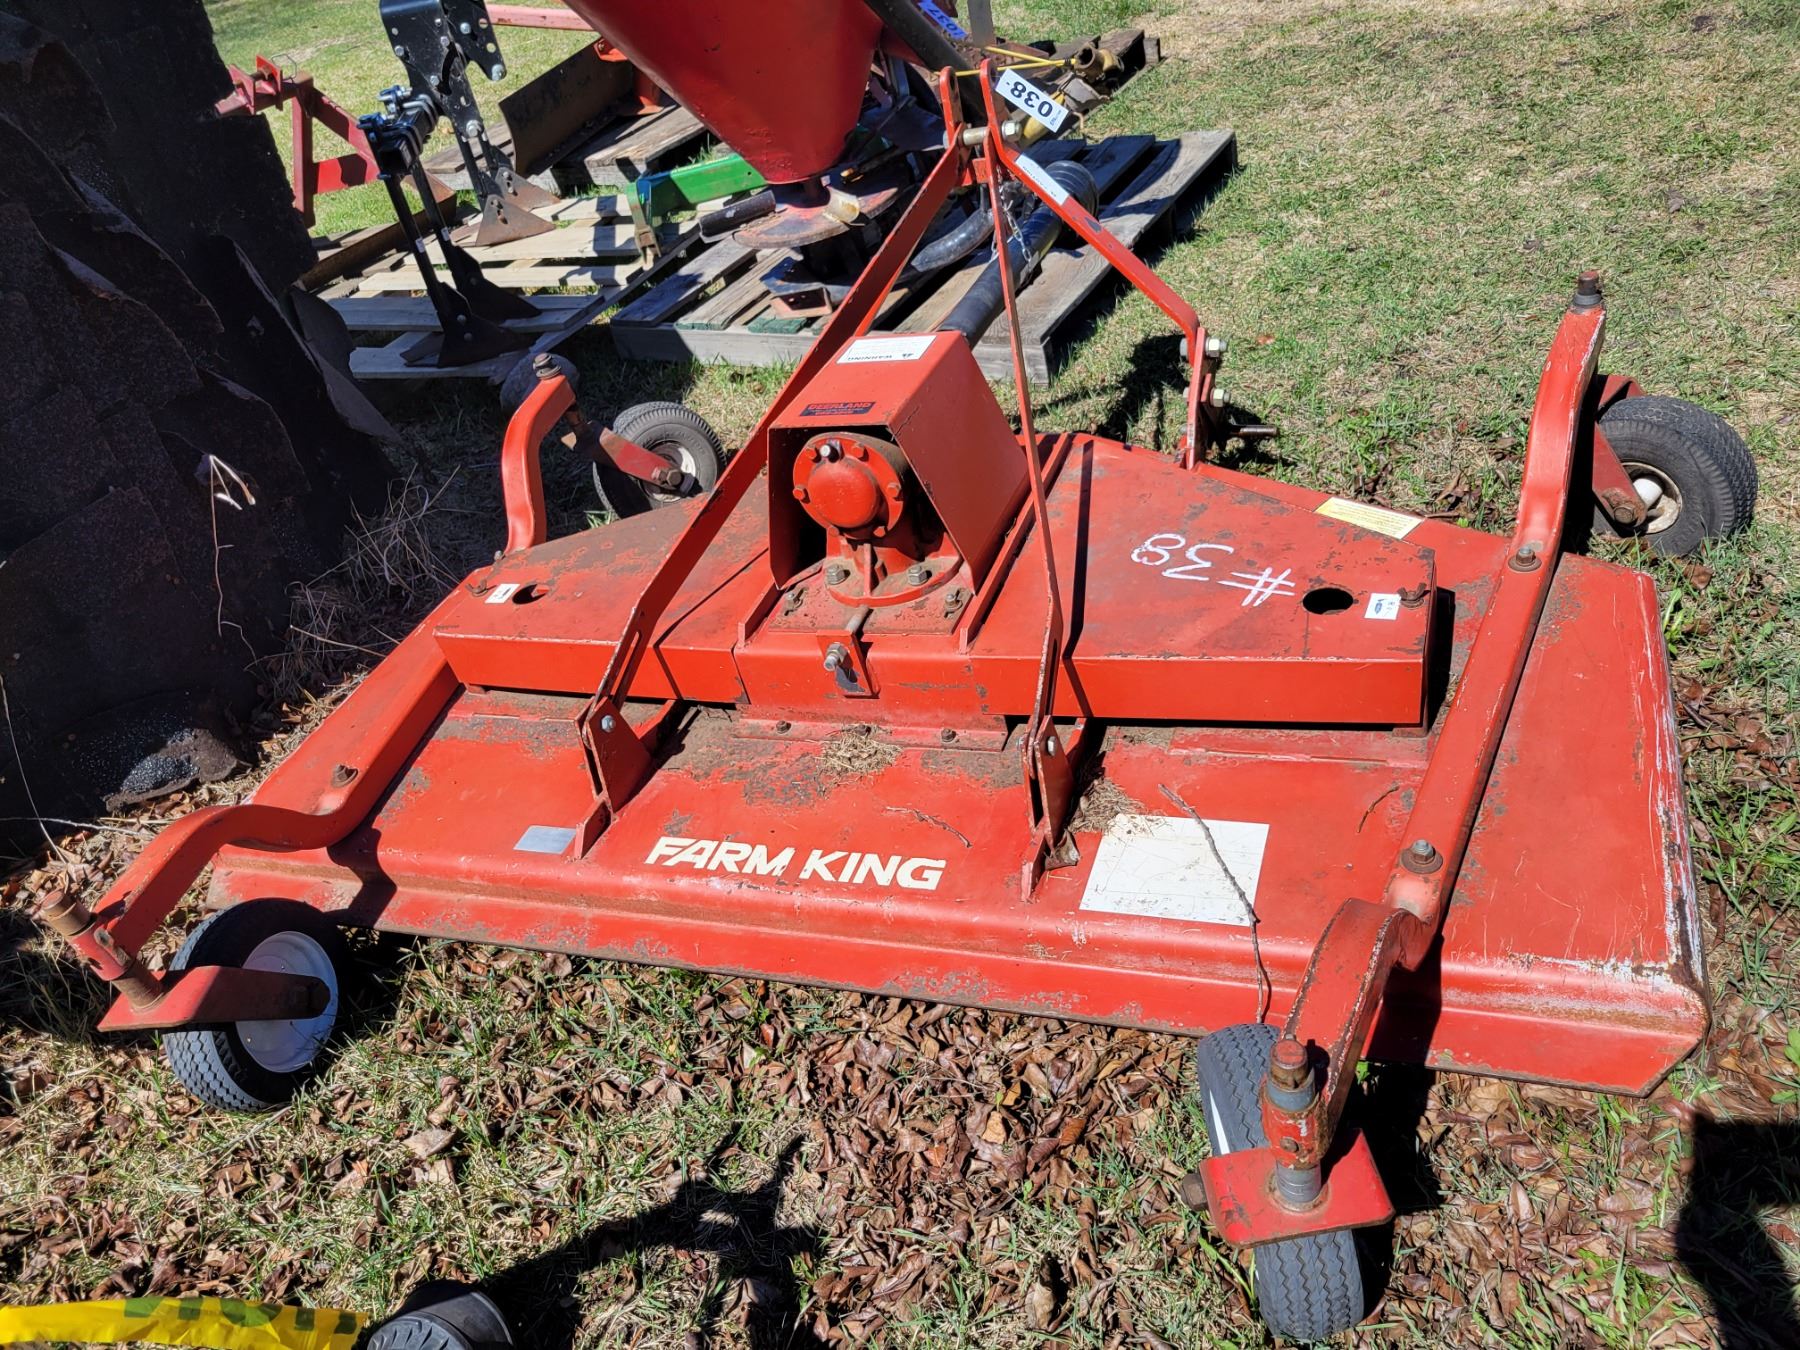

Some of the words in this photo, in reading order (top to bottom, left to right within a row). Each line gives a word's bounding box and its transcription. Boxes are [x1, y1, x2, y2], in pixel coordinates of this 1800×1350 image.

[1010, 81, 1053, 118] 038
[645, 836, 796, 876] FARM
[799, 849, 947, 890] KING
